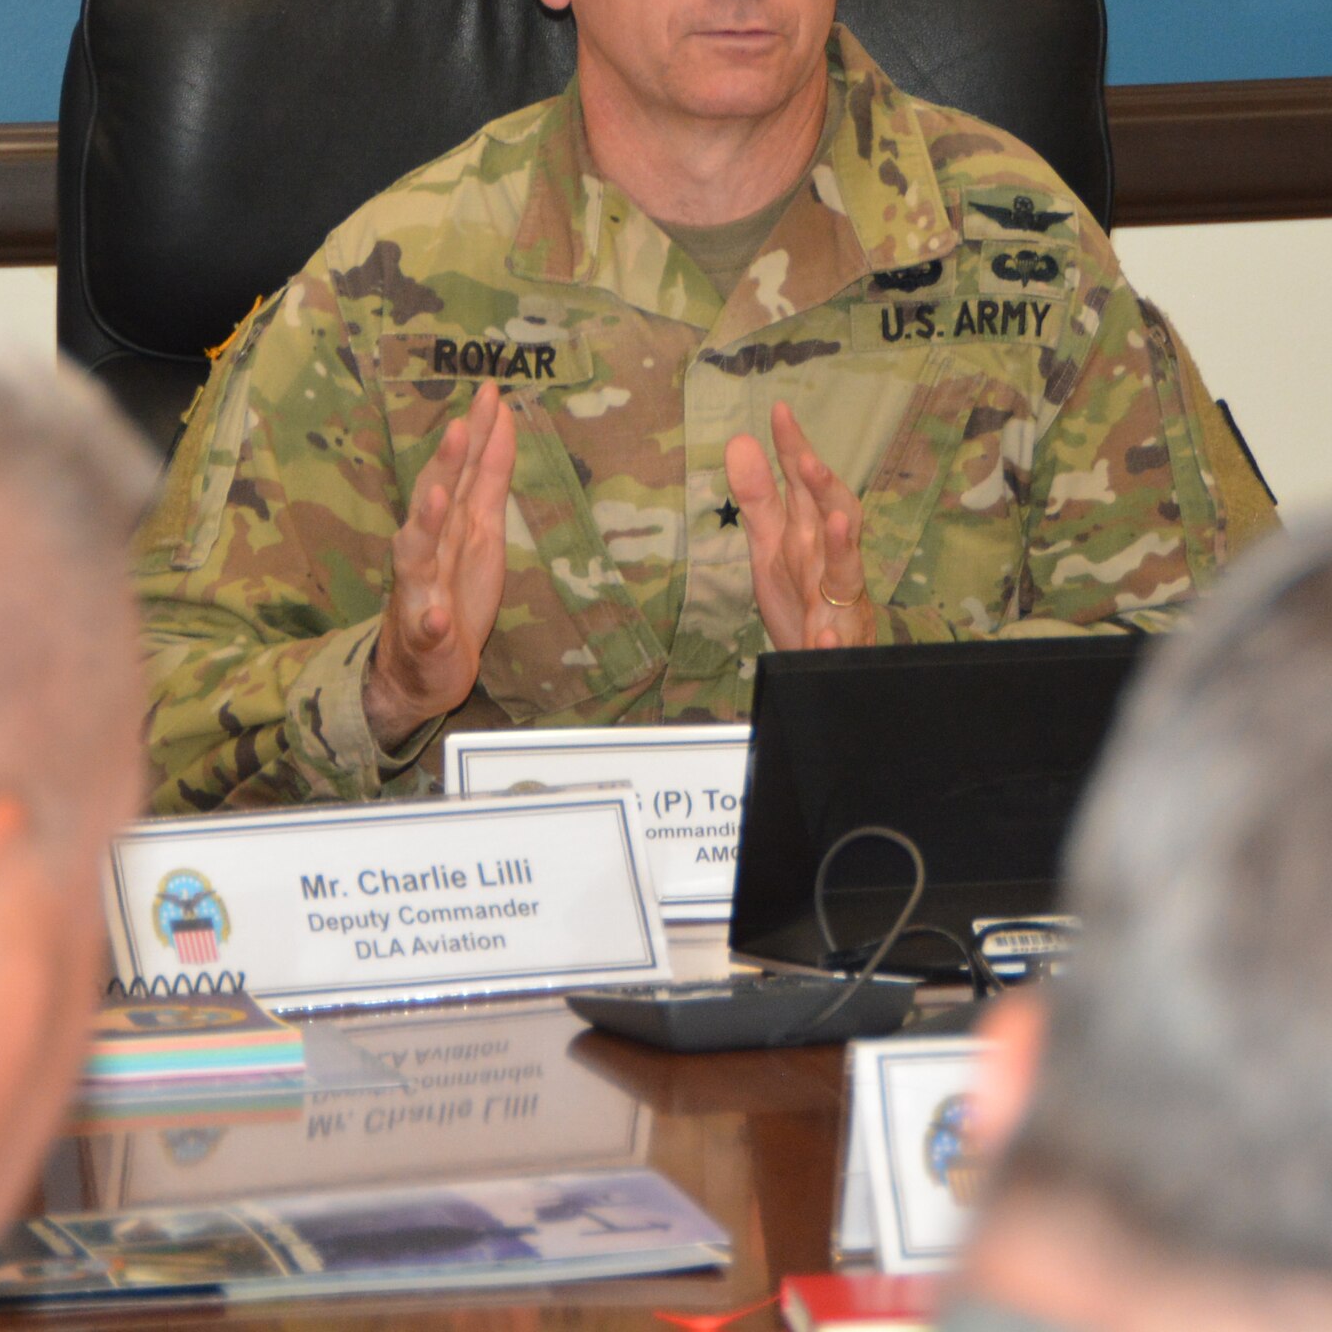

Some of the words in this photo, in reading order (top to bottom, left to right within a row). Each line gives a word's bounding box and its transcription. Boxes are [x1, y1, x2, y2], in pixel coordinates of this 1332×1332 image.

[880, 305, 945, 343] U.S.
[953, 301, 1052, 338] ARMY
[433, 339, 557, 380] ROYAR
[653, 790, 693, 819] (P)
[702, 788, 745, 813] To
[300, 873, 348, 900] Mr.
[358, 863, 467, 896] Charlie
[477, 858, 533, 887] Lilli
[308, 909, 390, 933] Deputy
[398, 898, 539, 925] Commander
[355, 938, 405, 960] DLA
[412, 933, 506, 956] Aviation
